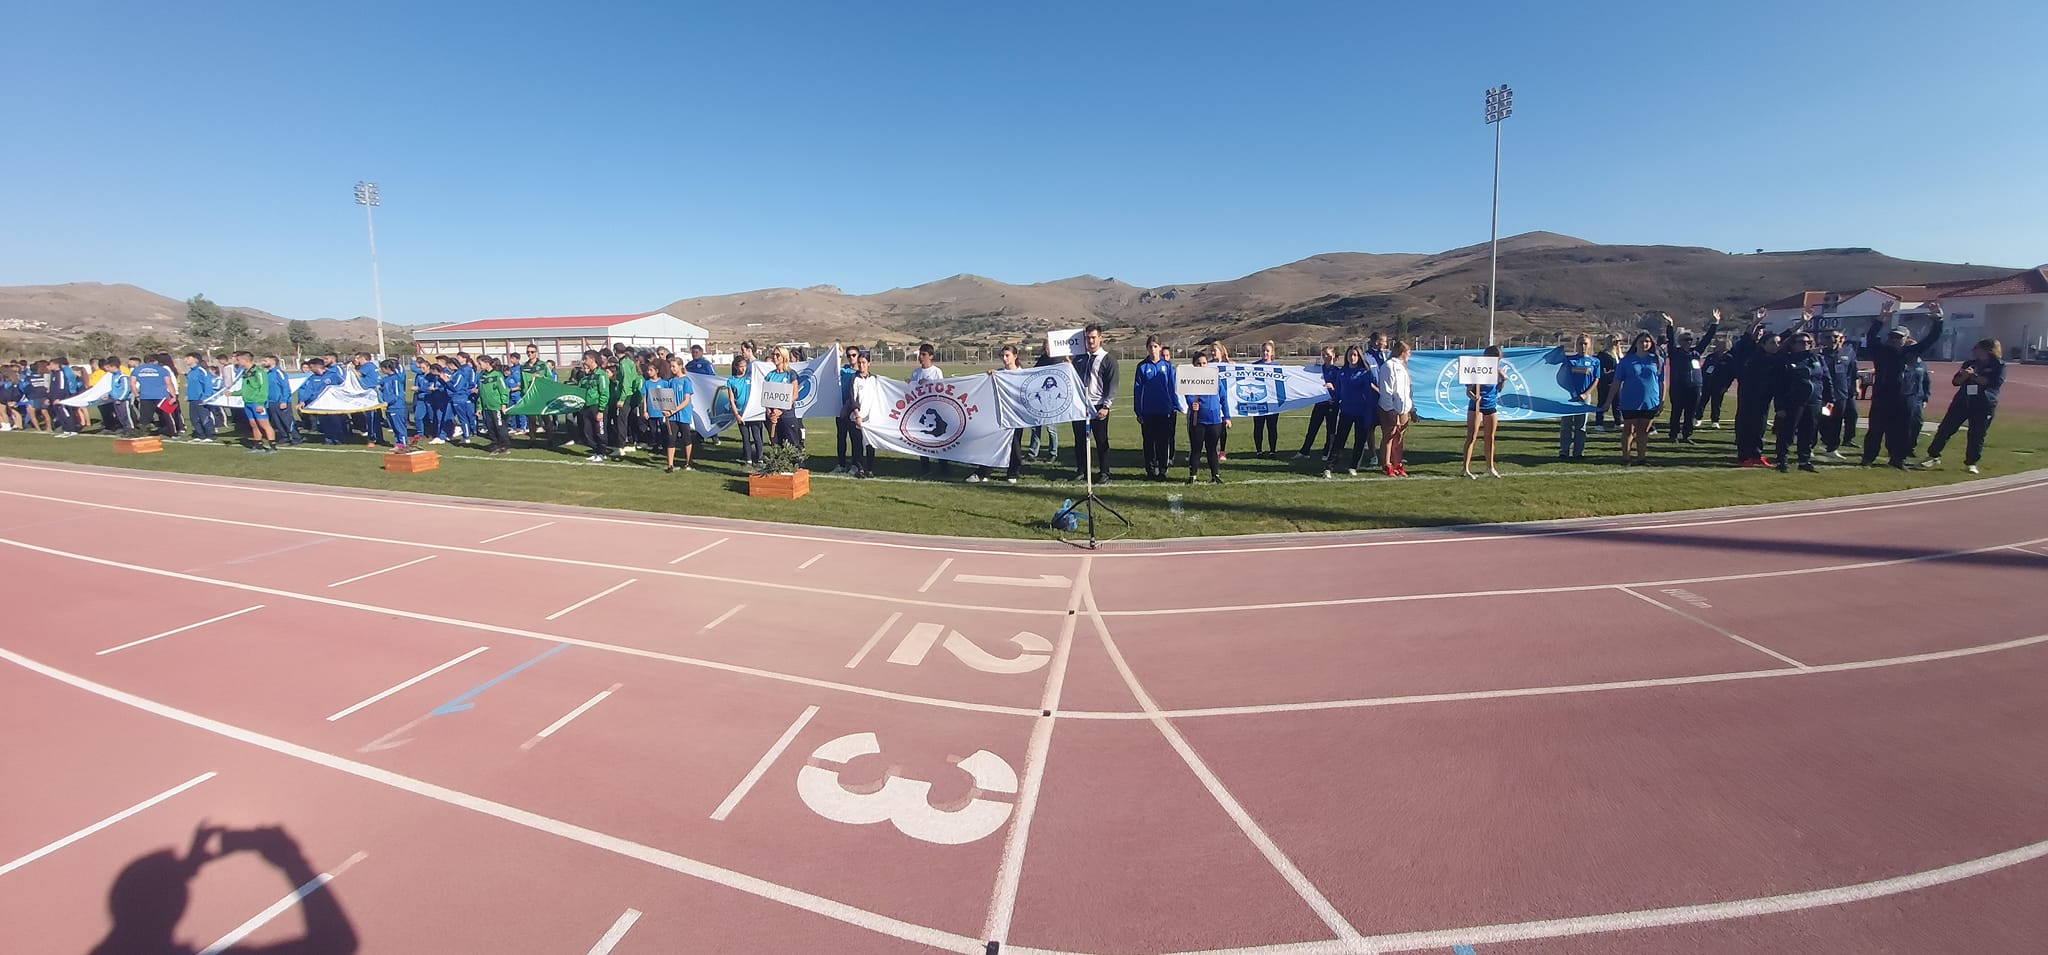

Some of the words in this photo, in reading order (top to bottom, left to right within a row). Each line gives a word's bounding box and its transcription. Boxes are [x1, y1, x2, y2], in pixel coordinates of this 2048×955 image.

[1236, 370, 1287, 380] ΜΥΚΟΝΟΥ
[1463, 366, 1493, 375] ΝΑΞΟΣ
[763, 392, 790, 402] ΠΑΡΟΣ
[886, 622, 1053, 674] 2
[796, 732, 1018, 845] 3
